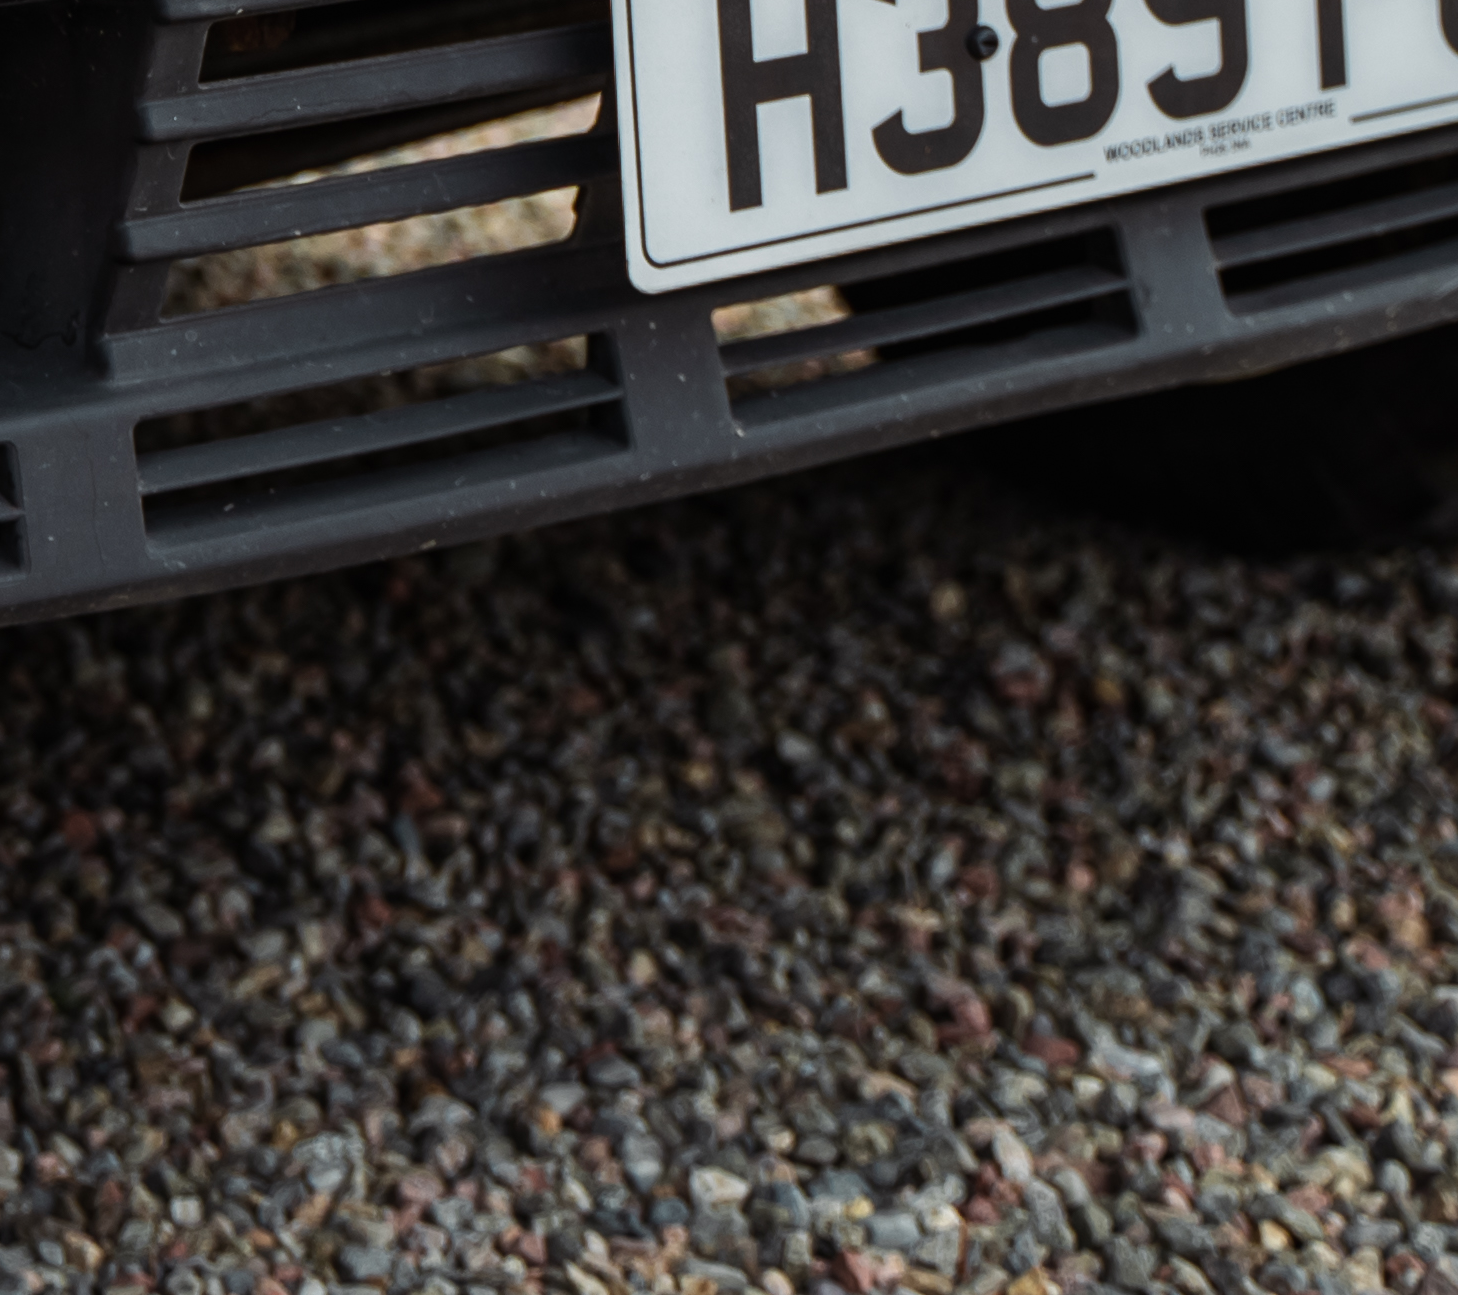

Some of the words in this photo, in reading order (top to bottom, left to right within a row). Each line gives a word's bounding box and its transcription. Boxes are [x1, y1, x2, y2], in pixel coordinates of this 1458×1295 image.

[1104, 129, 1205, 163] WOODLANDS
[1208, 111, 1273, 141] SERVICE
[1275, 98, 1336, 127] CENTRE
